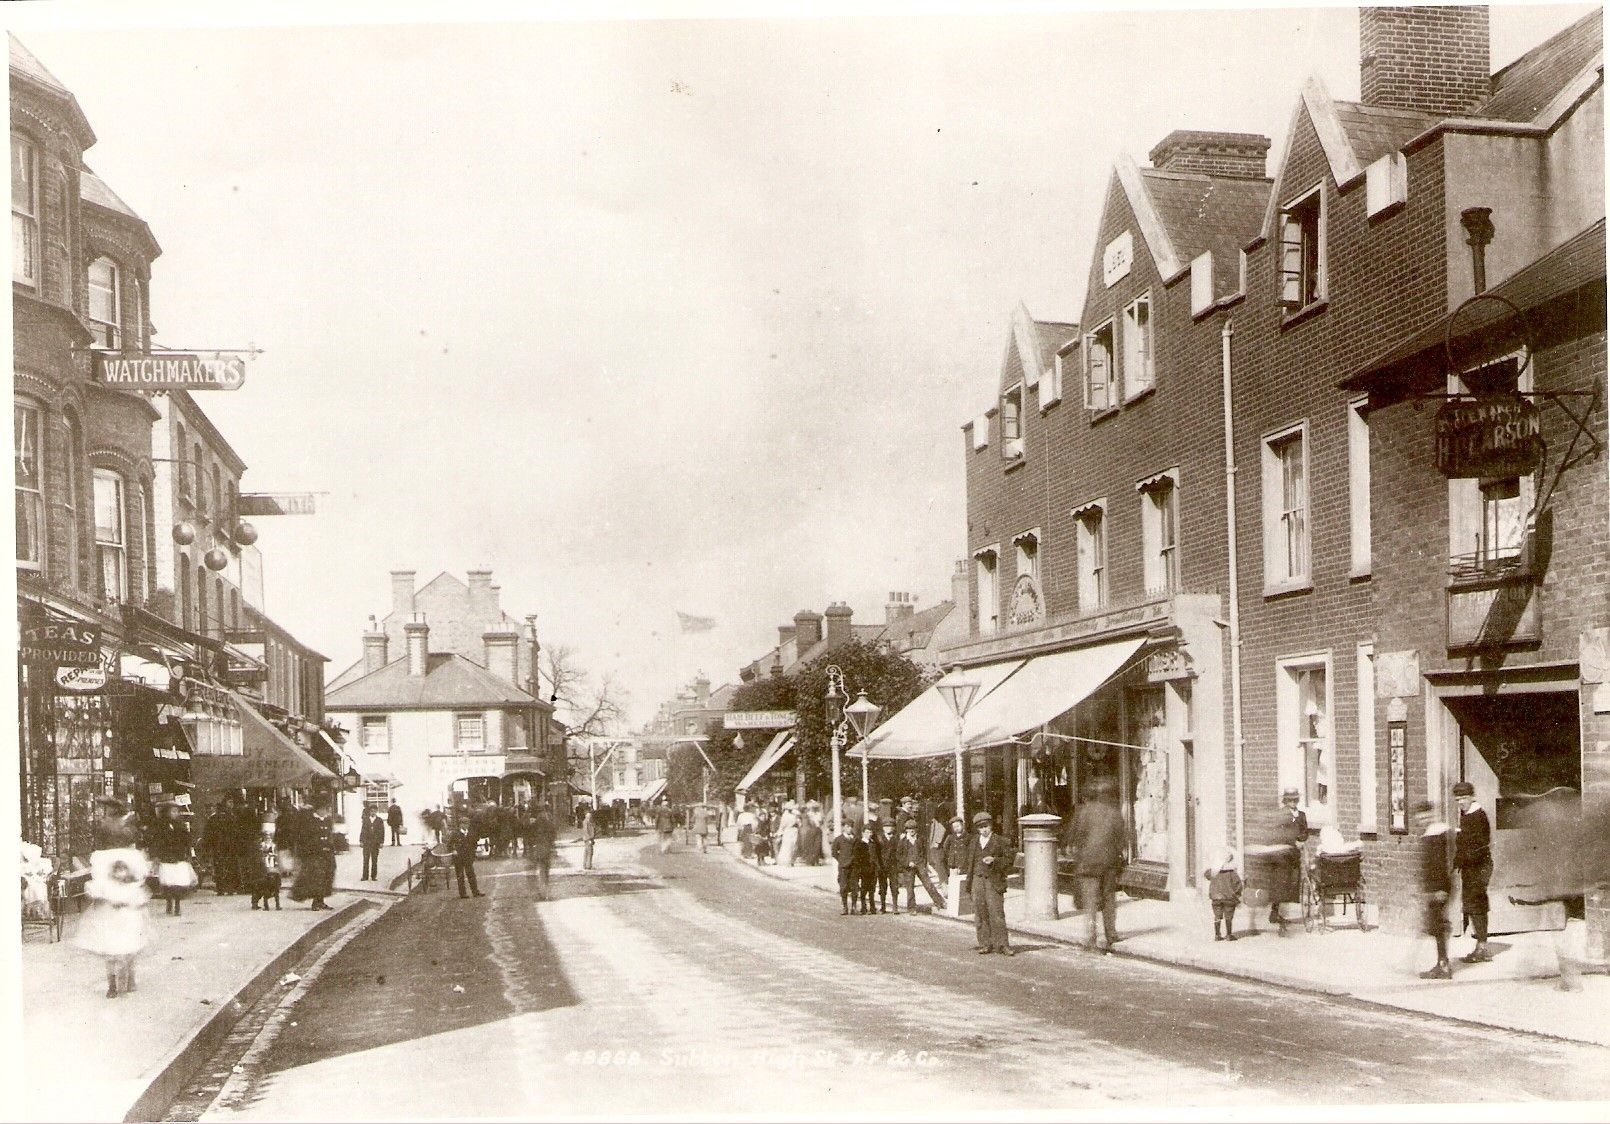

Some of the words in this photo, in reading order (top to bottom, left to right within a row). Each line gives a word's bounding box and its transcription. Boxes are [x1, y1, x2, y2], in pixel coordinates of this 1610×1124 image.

[103, 359, 240, 384] WATCHMAKERS
[25, 625, 95, 645] TEAS
[21, 647, 98, 663] PROVIDED
